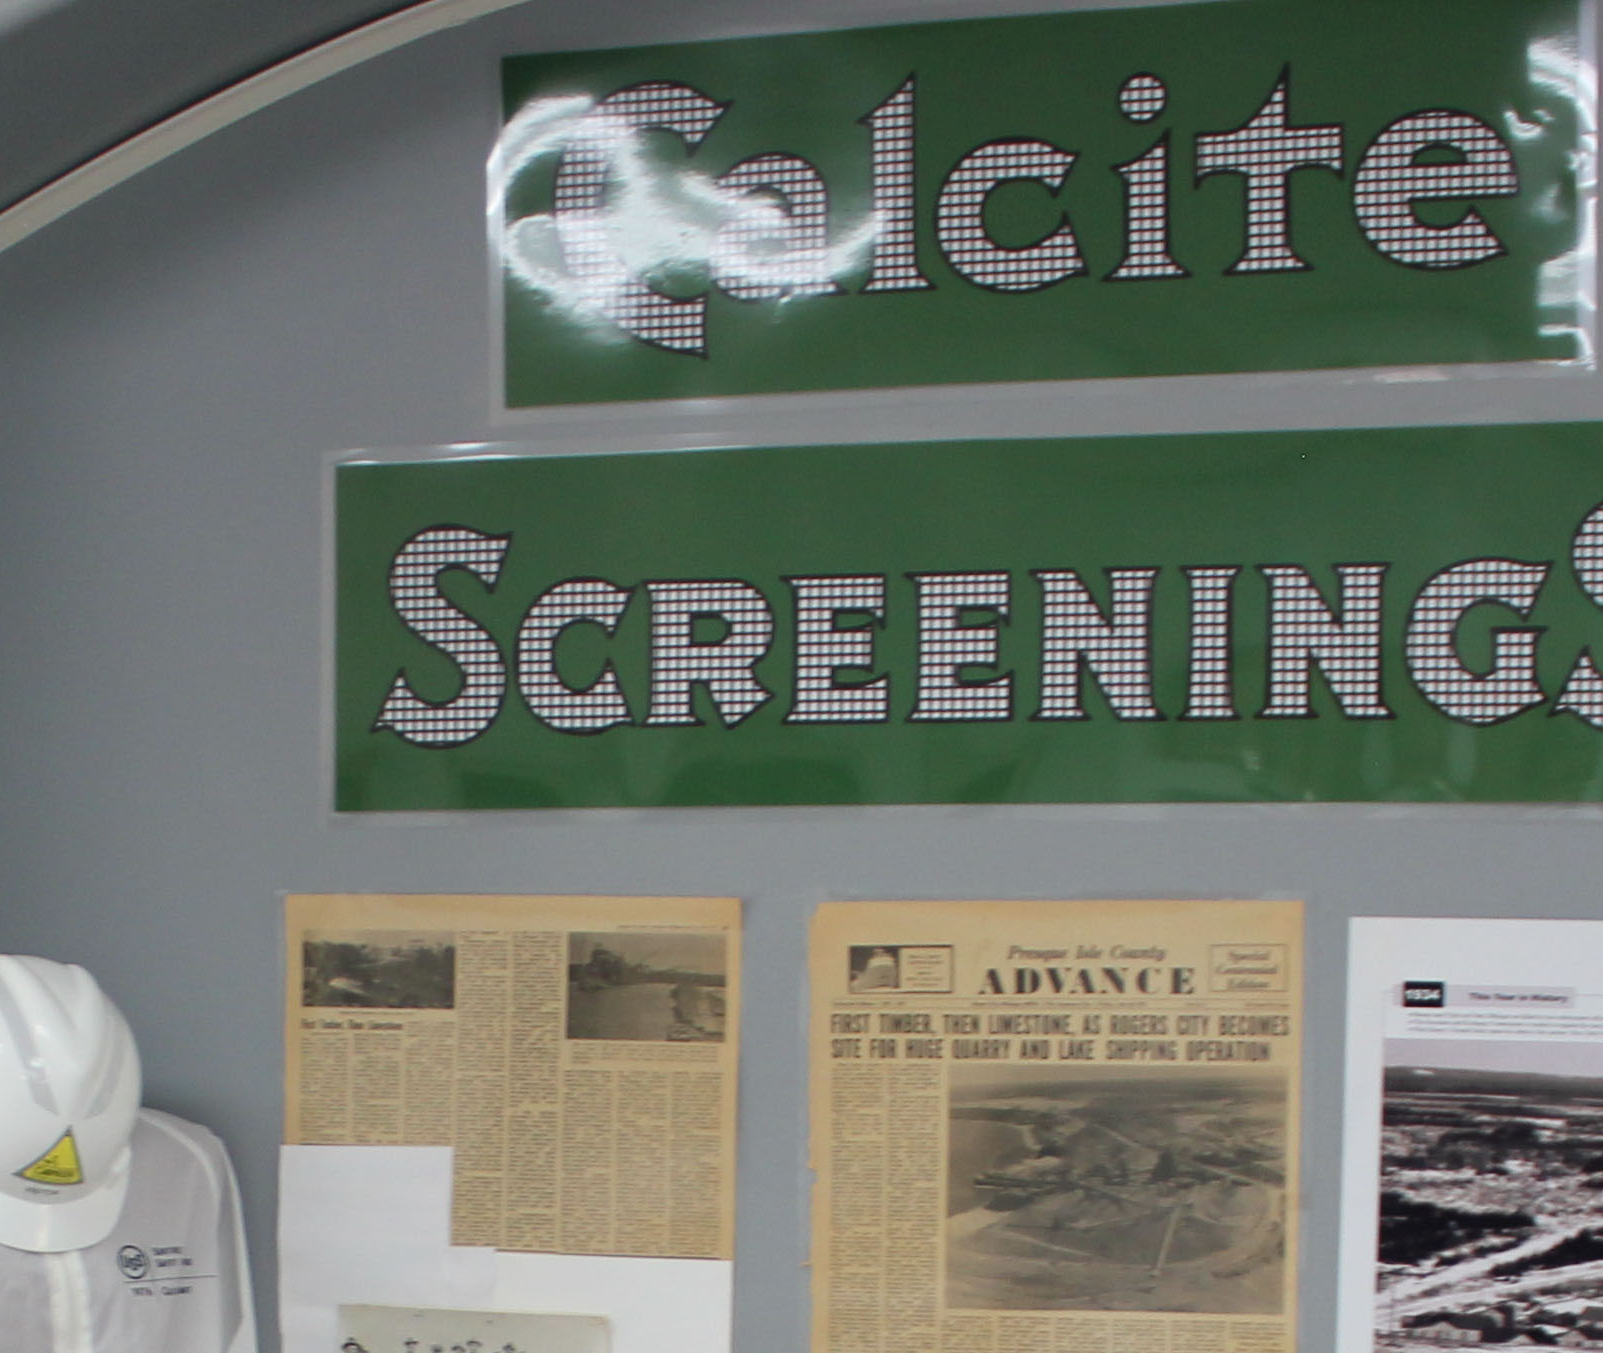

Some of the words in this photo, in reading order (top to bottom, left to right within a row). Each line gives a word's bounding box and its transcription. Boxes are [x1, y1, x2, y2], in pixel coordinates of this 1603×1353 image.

[553, 62, 1520, 360] Calcite
[978, 967, 1195, 995] ADVANCE
[831, 1013, 870, 1034] FIRST
[943, 1014, 980, 1034] THEN
[1082, 1014, 1101, 1034] AS
[1110, 1015, 1167, 1035] ROGERS
[1176, 1015, 1208, 1035] CITY
[1218, 1015, 1289, 1036] BECOMES
[831, 1038, 861, 1058] SITE
[870, 1038, 896, 1058] FOR
[905, 1038, 944, 1059] HUGE
[952, 1038, 1010, 1059] QUARRY
[1019, 1039, 1051, 1060] AND
[1058, 1039, 1094, 1060] LAKE
[1106, 1040, 1177, 1060] SHIPPING
[1186, 1040, 1270, 1061] OPERATION
